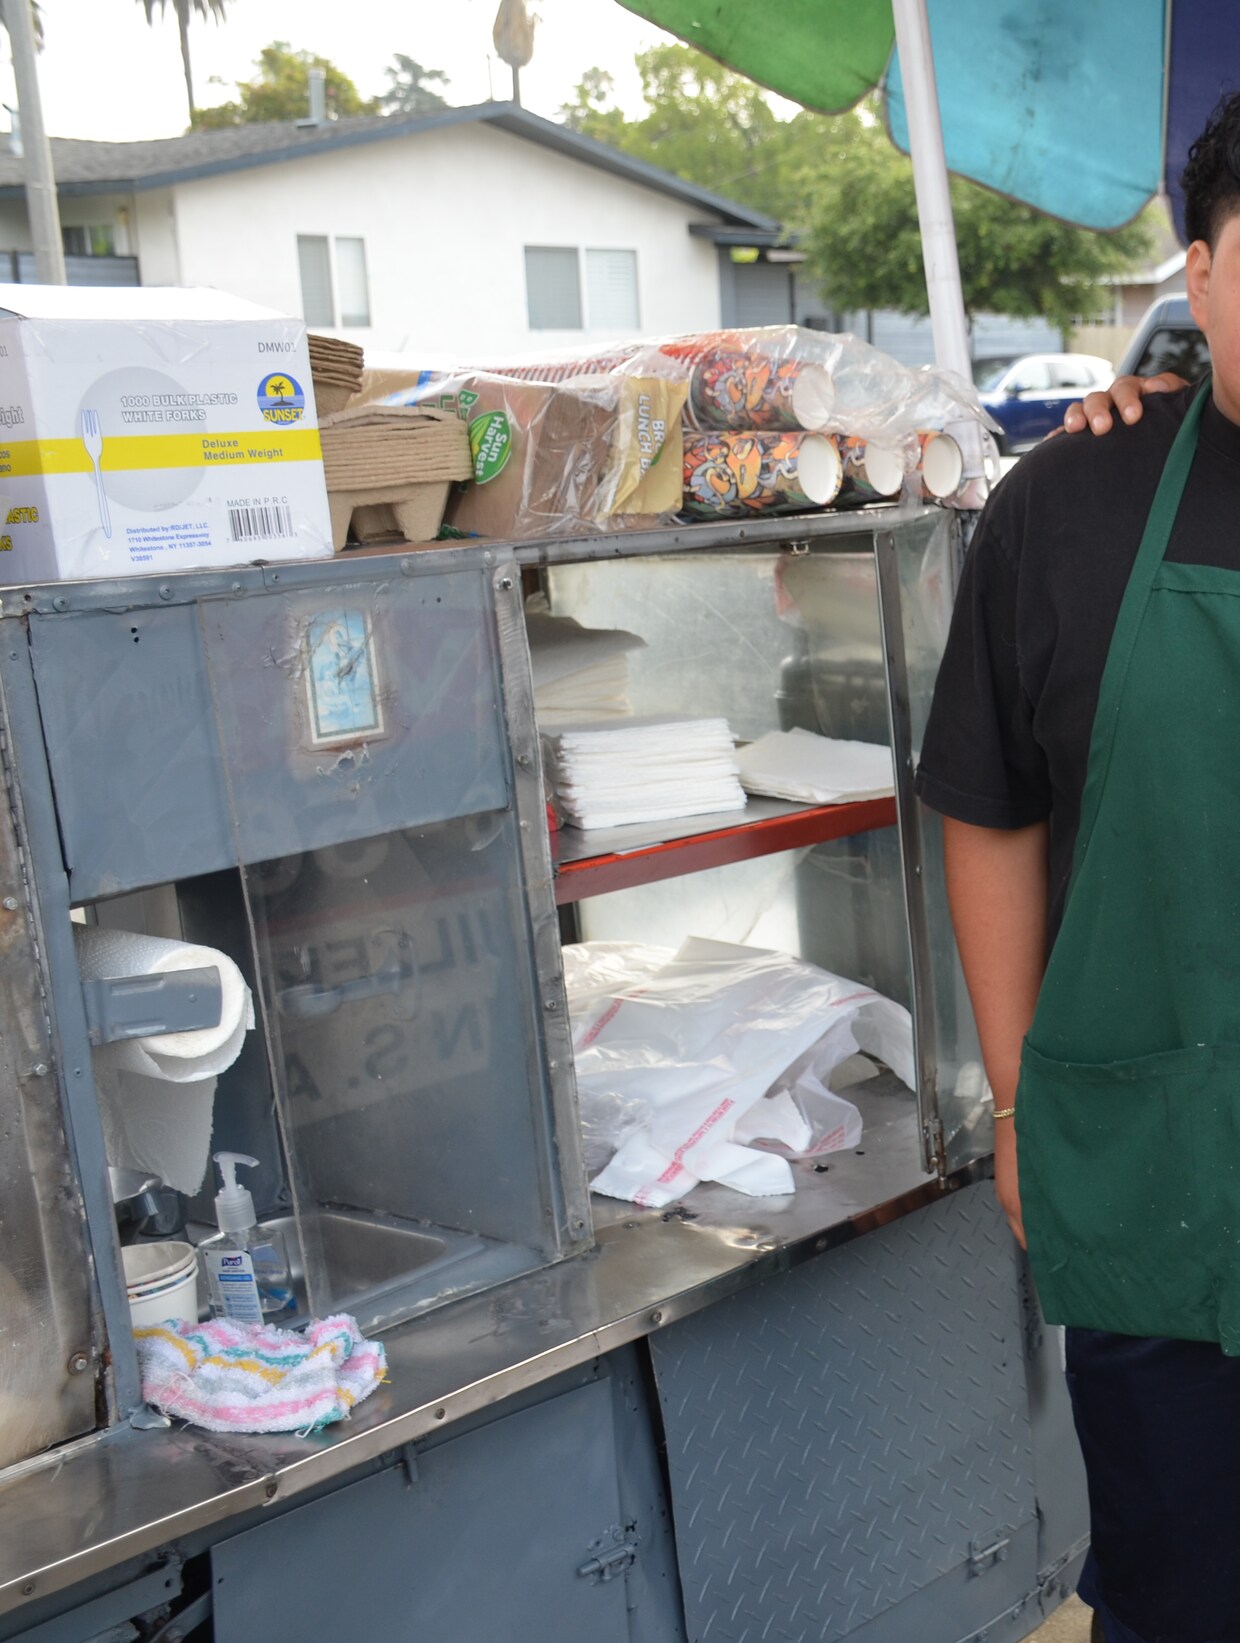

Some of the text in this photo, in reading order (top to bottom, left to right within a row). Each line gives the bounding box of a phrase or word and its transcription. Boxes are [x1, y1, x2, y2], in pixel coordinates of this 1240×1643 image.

[121, 393, 238, 407] 1000 BULK PLASTIC
[122, 409, 207, 423] WHITE FORKS
[263, 407, 304, 422] SUNSET
[638, 394, 653, 453] LUNCH
[202, 439, 239, 449] Deluxe
[475, 416, 504, 477] Harvest
[487, 433, 507, 462] Sun
[204, 447, 283, 461] Medium Weight
[227, 498, 250, 507] MADE
[252, 497, 262, 506] IN
